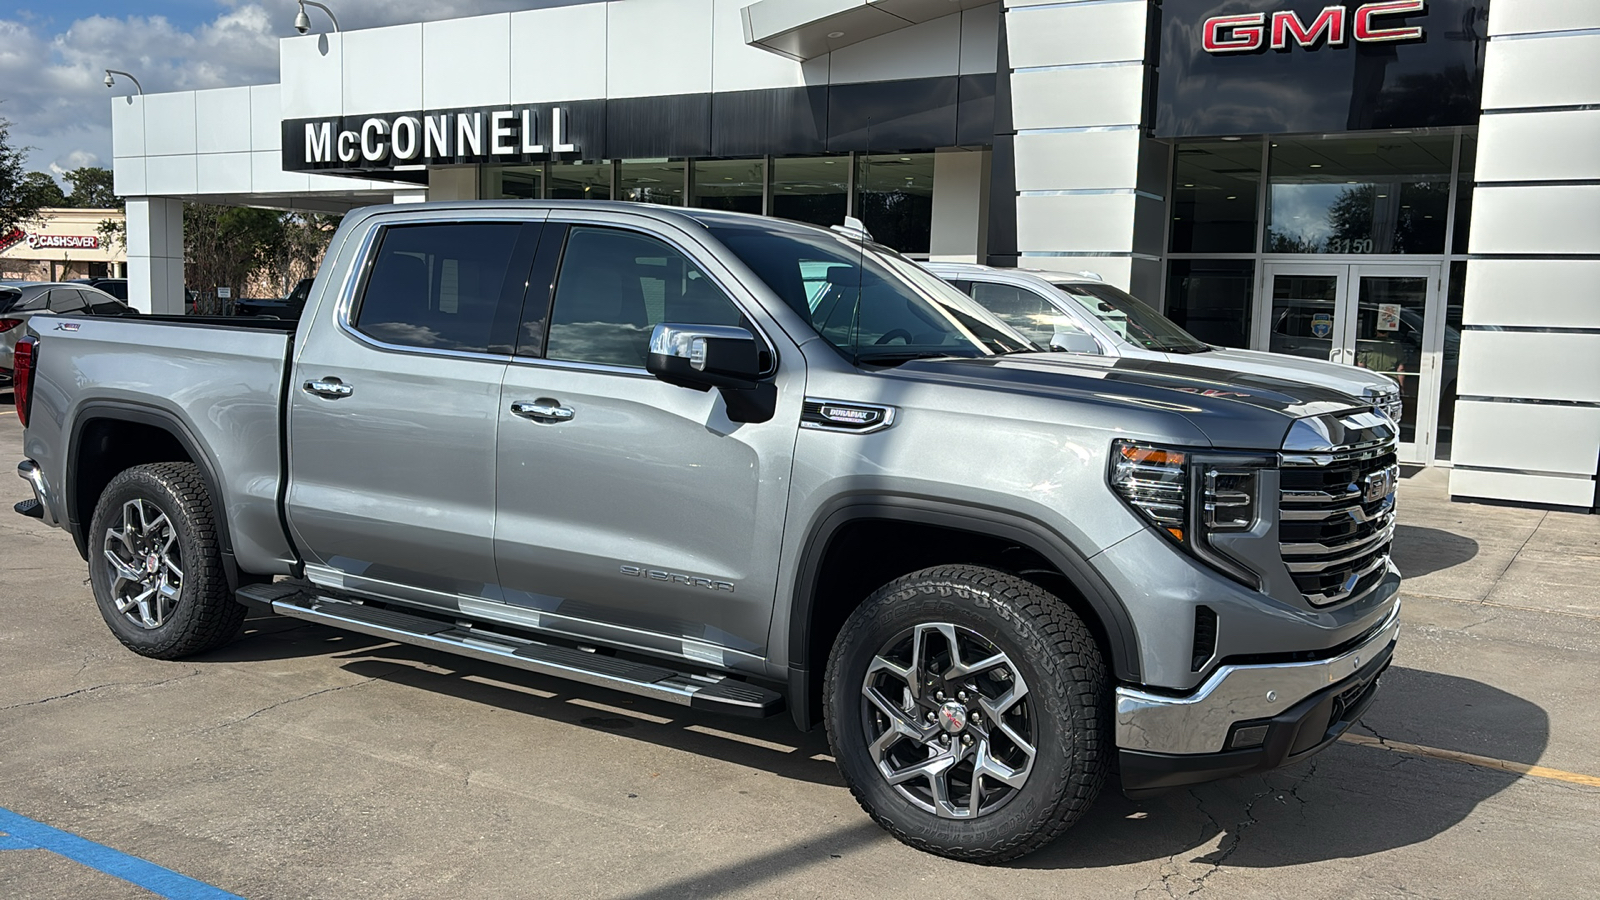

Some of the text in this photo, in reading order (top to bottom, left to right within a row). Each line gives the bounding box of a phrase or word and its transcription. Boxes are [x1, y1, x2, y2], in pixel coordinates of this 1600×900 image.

[1202, 0, 1424, 52] GMC
[304, 107, 577, 163] McCONNELL
[1332, 238, 1373, 254] 3150
[829, 408, 868, 419] DURAMAX
[620, 565, 735, 592] SIERRA
